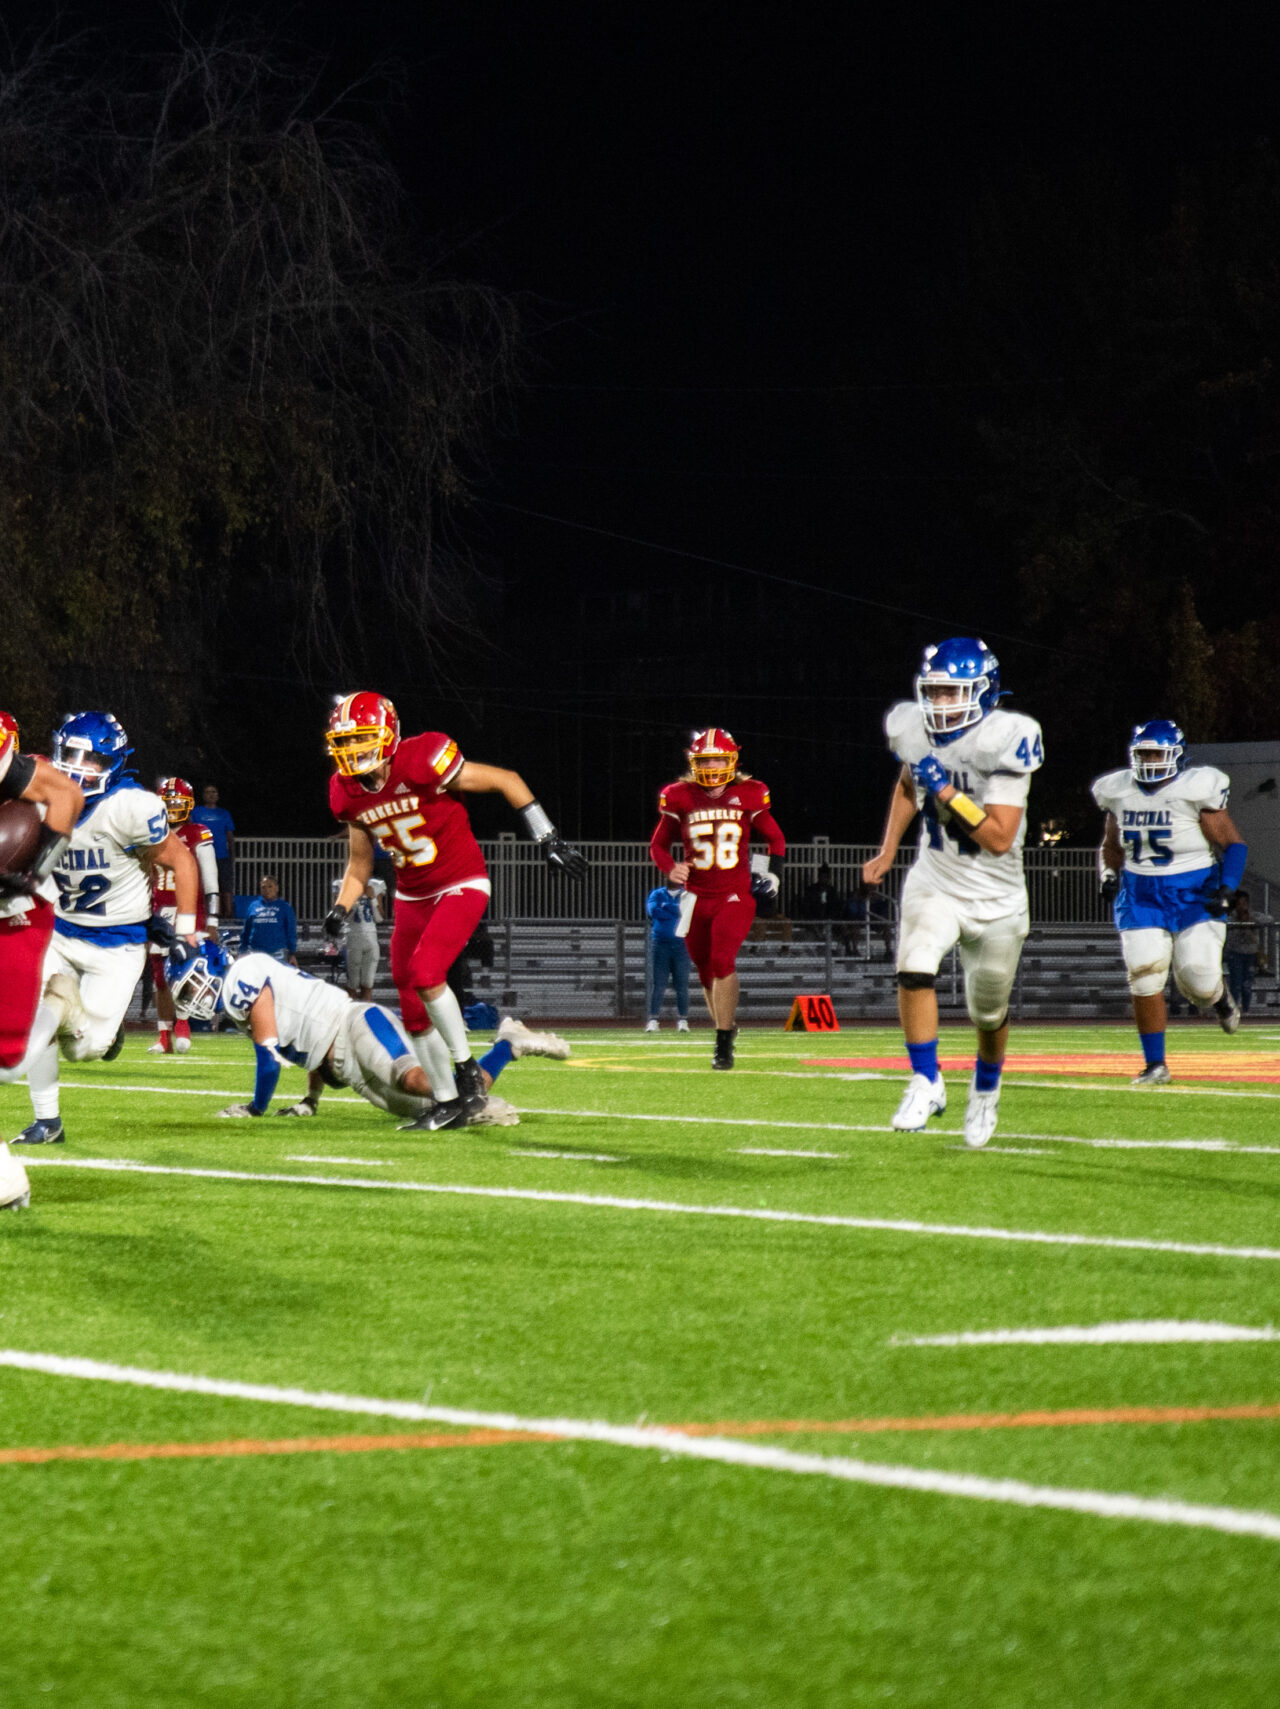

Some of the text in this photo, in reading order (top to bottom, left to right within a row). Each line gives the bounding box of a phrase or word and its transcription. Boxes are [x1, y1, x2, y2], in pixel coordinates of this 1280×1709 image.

[1015, 734, 1042, 768] 44
[356, 797, 419, 824] ERKELEY
[688, 808, 744, 824] BERKELEY
[1123, 810, 1172, 826] ENCINAL
[372, 813, 438, 868] 55
[688, 823, 743, 870] 58
[1123, 829, 1174, 866] 75
[57, 848, 110, 871] CINAL
[229, 979, 260, 1011] 54
[807, 997, 835, 1029] 40
